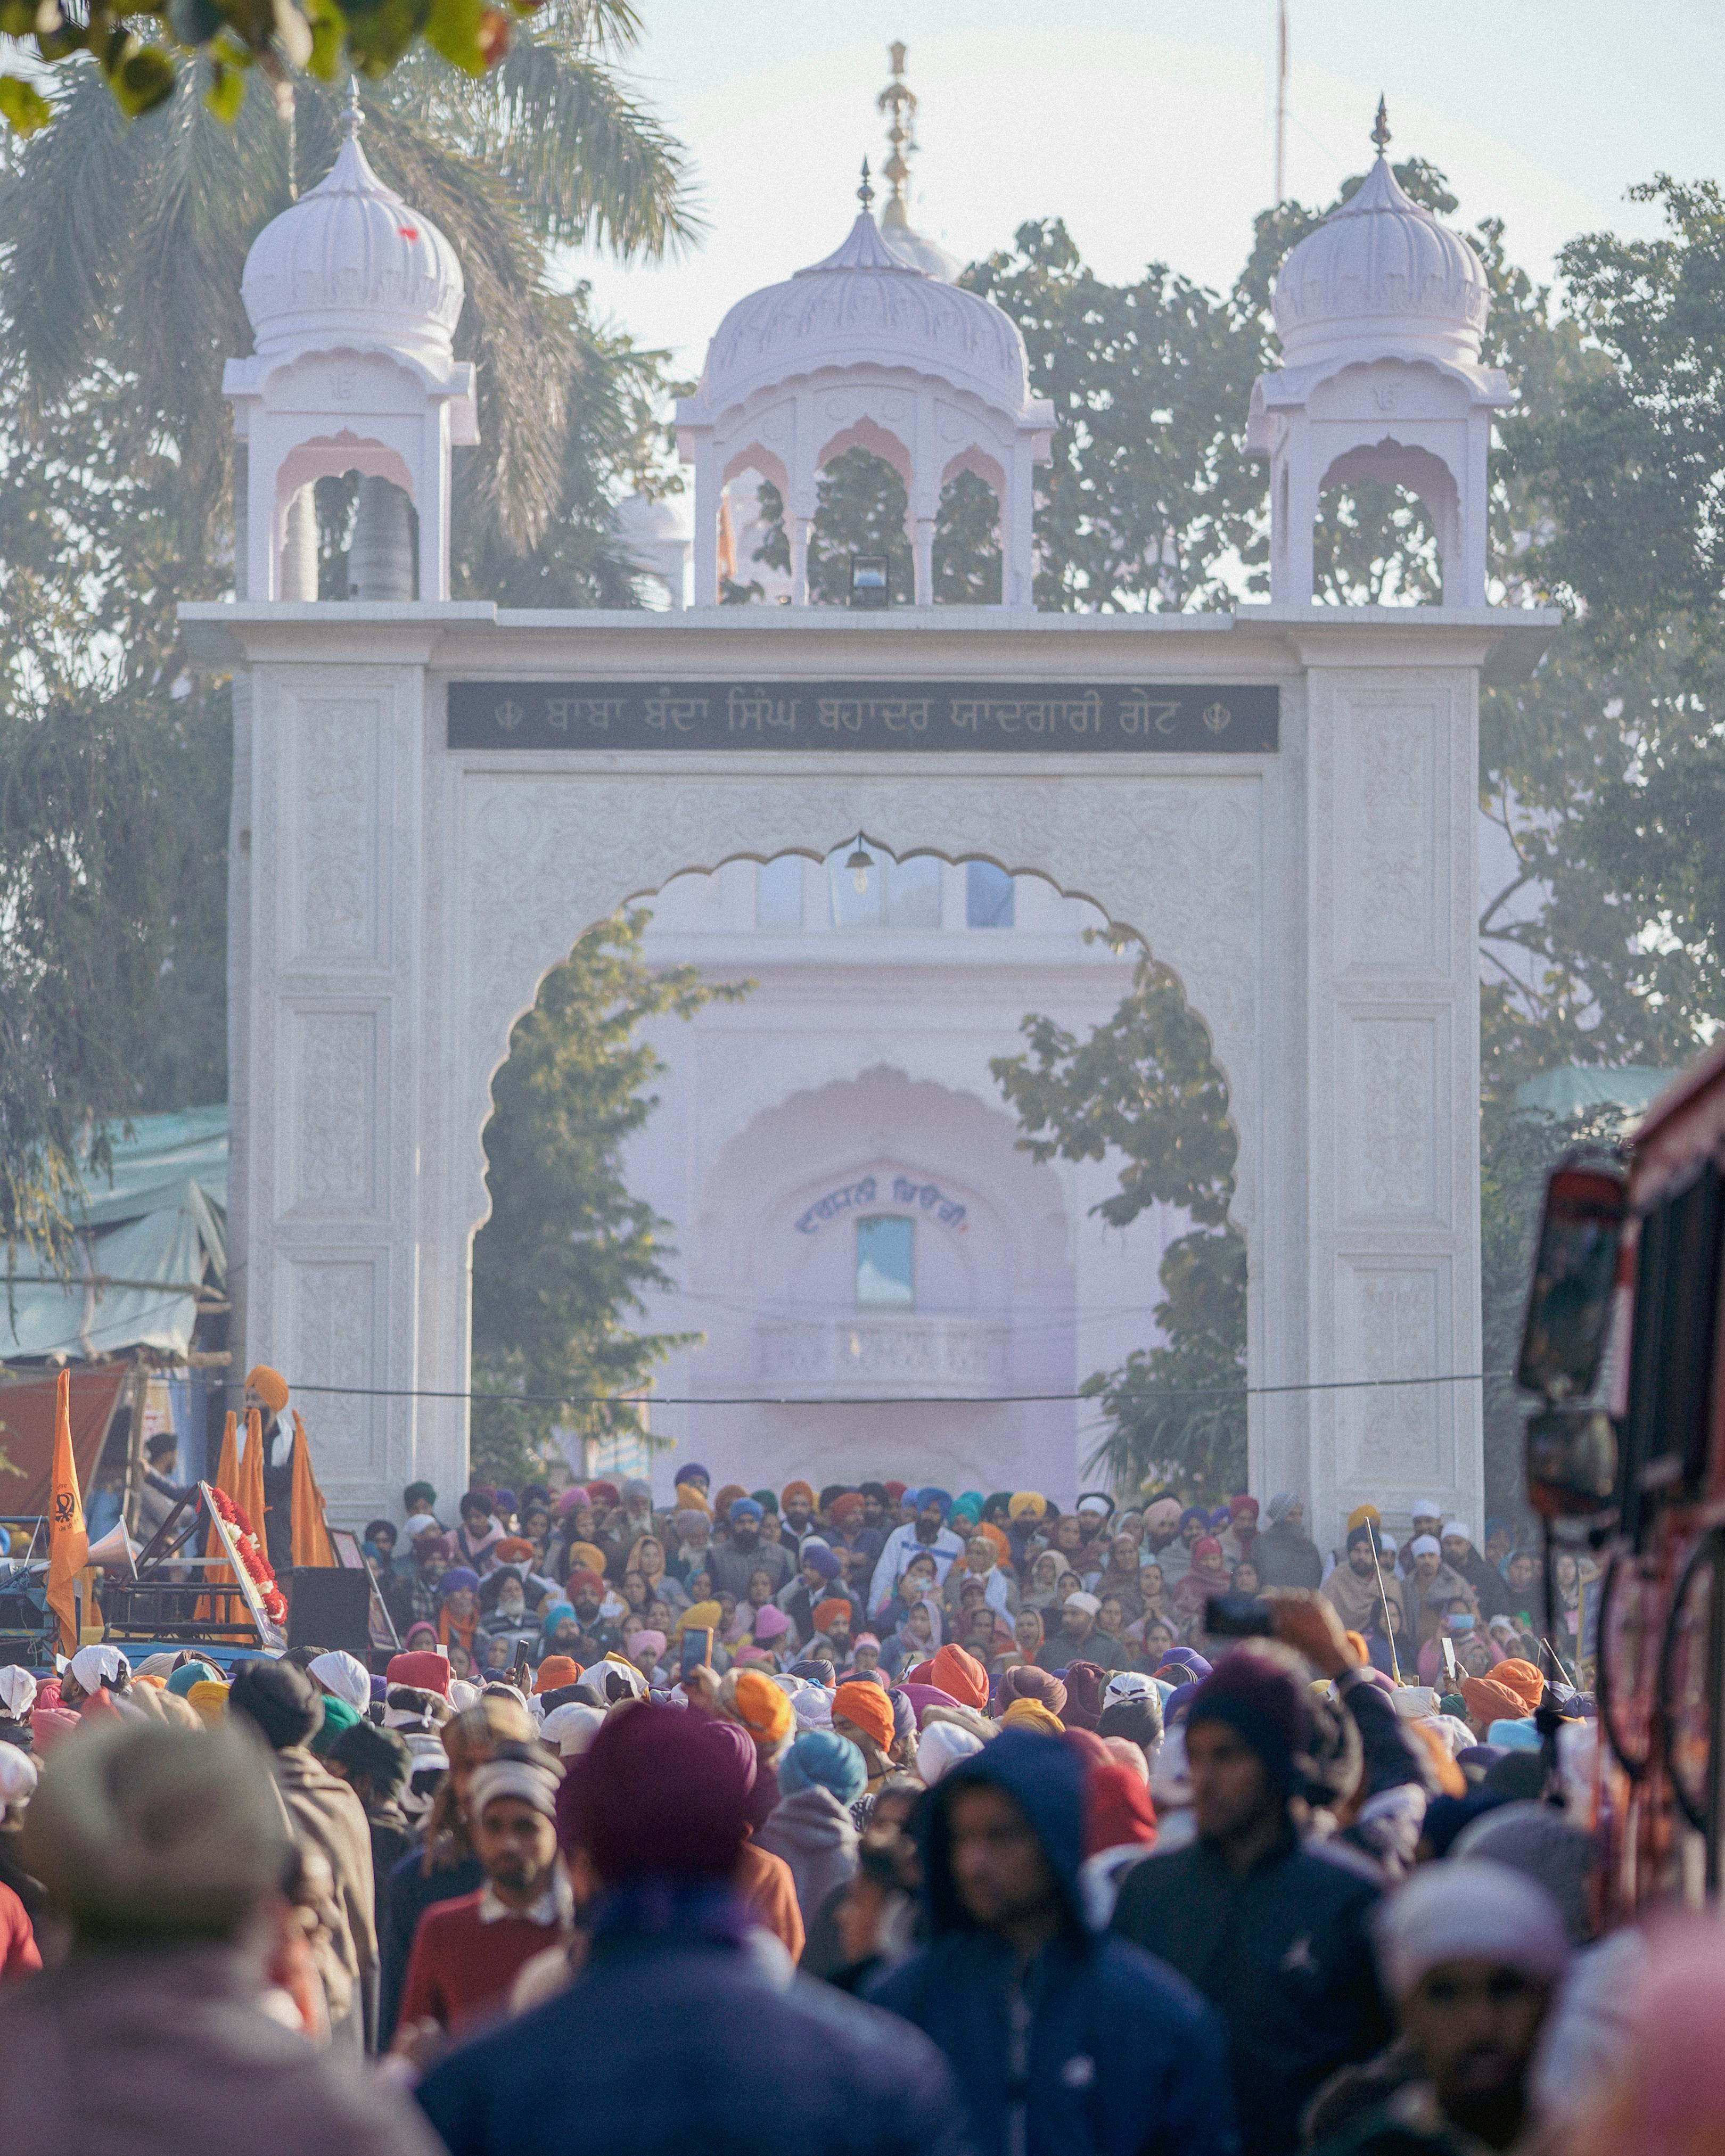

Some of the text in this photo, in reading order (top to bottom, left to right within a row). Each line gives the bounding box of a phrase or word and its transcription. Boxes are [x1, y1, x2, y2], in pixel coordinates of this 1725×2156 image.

[544, 686, 1181, 734] ਬਾਬਾ ਬੰਦਾ ਸਿੰਘ ਬਹਾਦਰ ਯਾਦਗਾਰੀ ਗੇਟ
